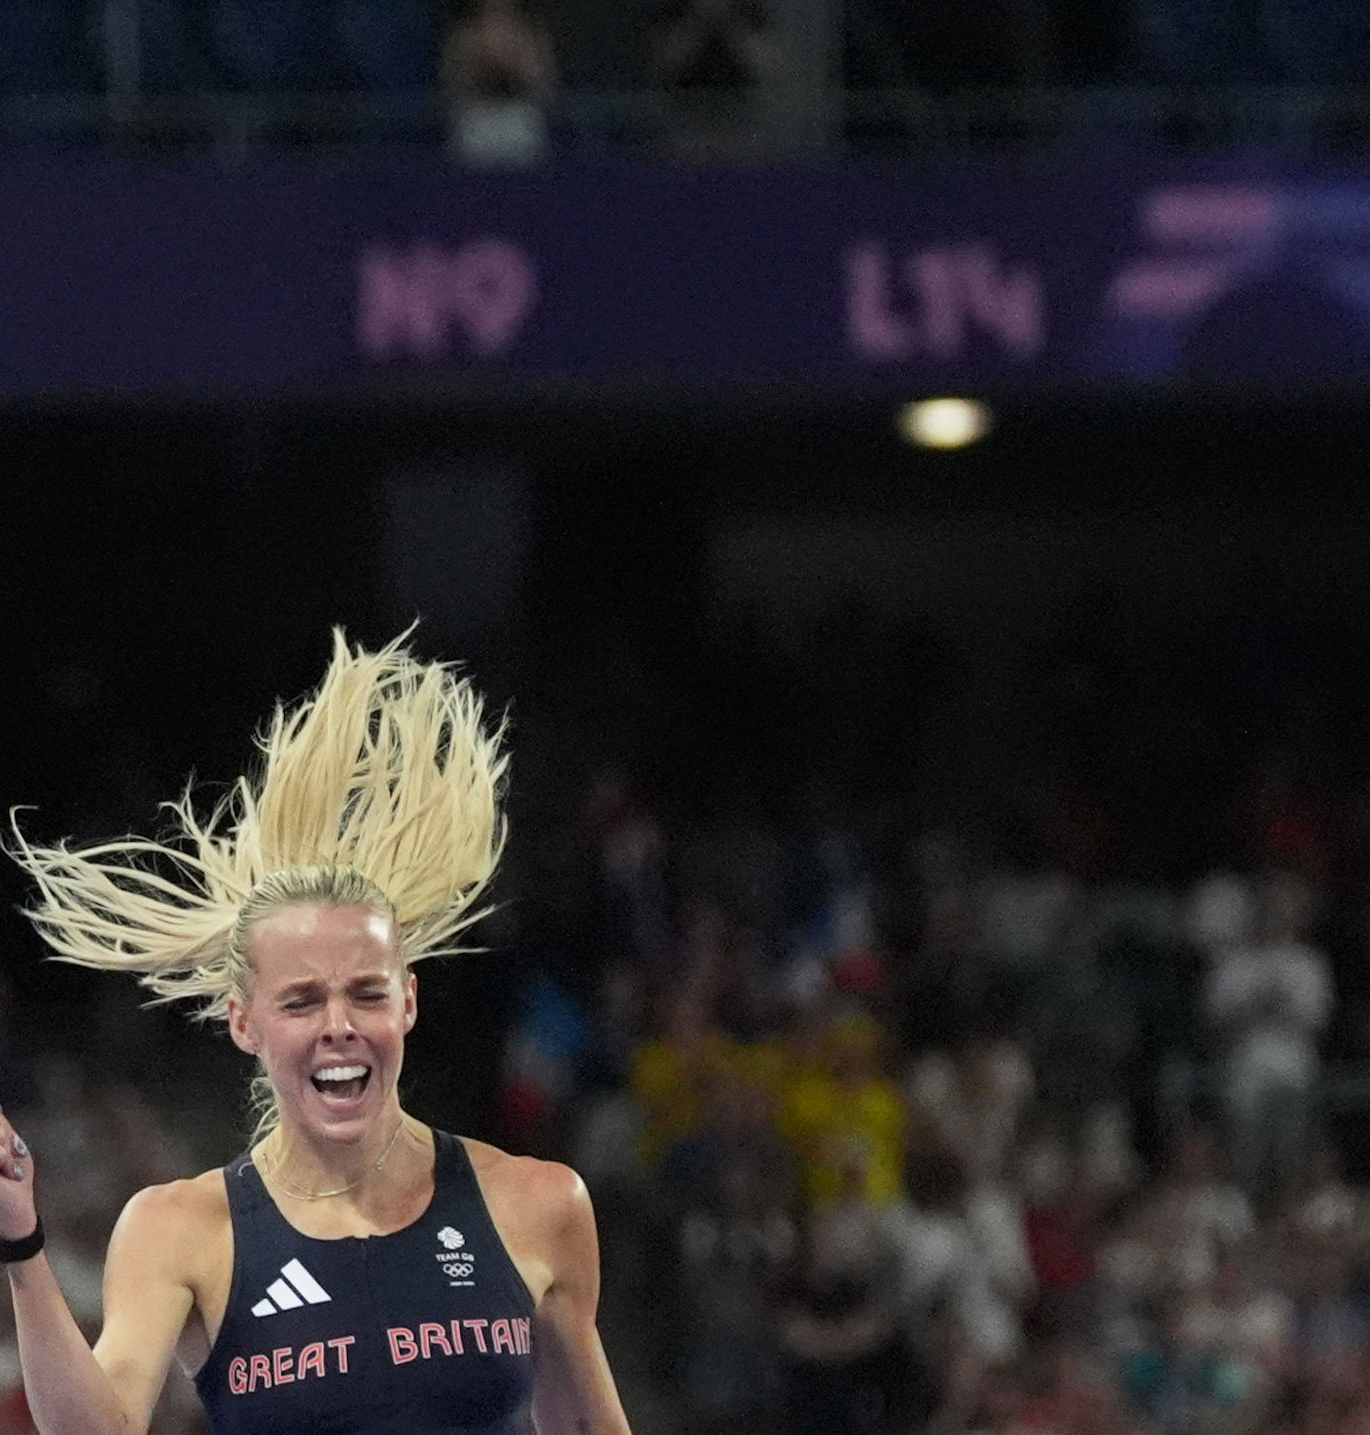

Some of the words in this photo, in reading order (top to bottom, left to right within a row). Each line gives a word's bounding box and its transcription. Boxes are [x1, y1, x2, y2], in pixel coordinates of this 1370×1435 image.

[436, 1253, 460, 1262] TEAM
[461, 1252, 475, 1262] GB
[228, 1335, 356, 1395] GREAT
[387, 1317, 531, 1366] BRITAIN
